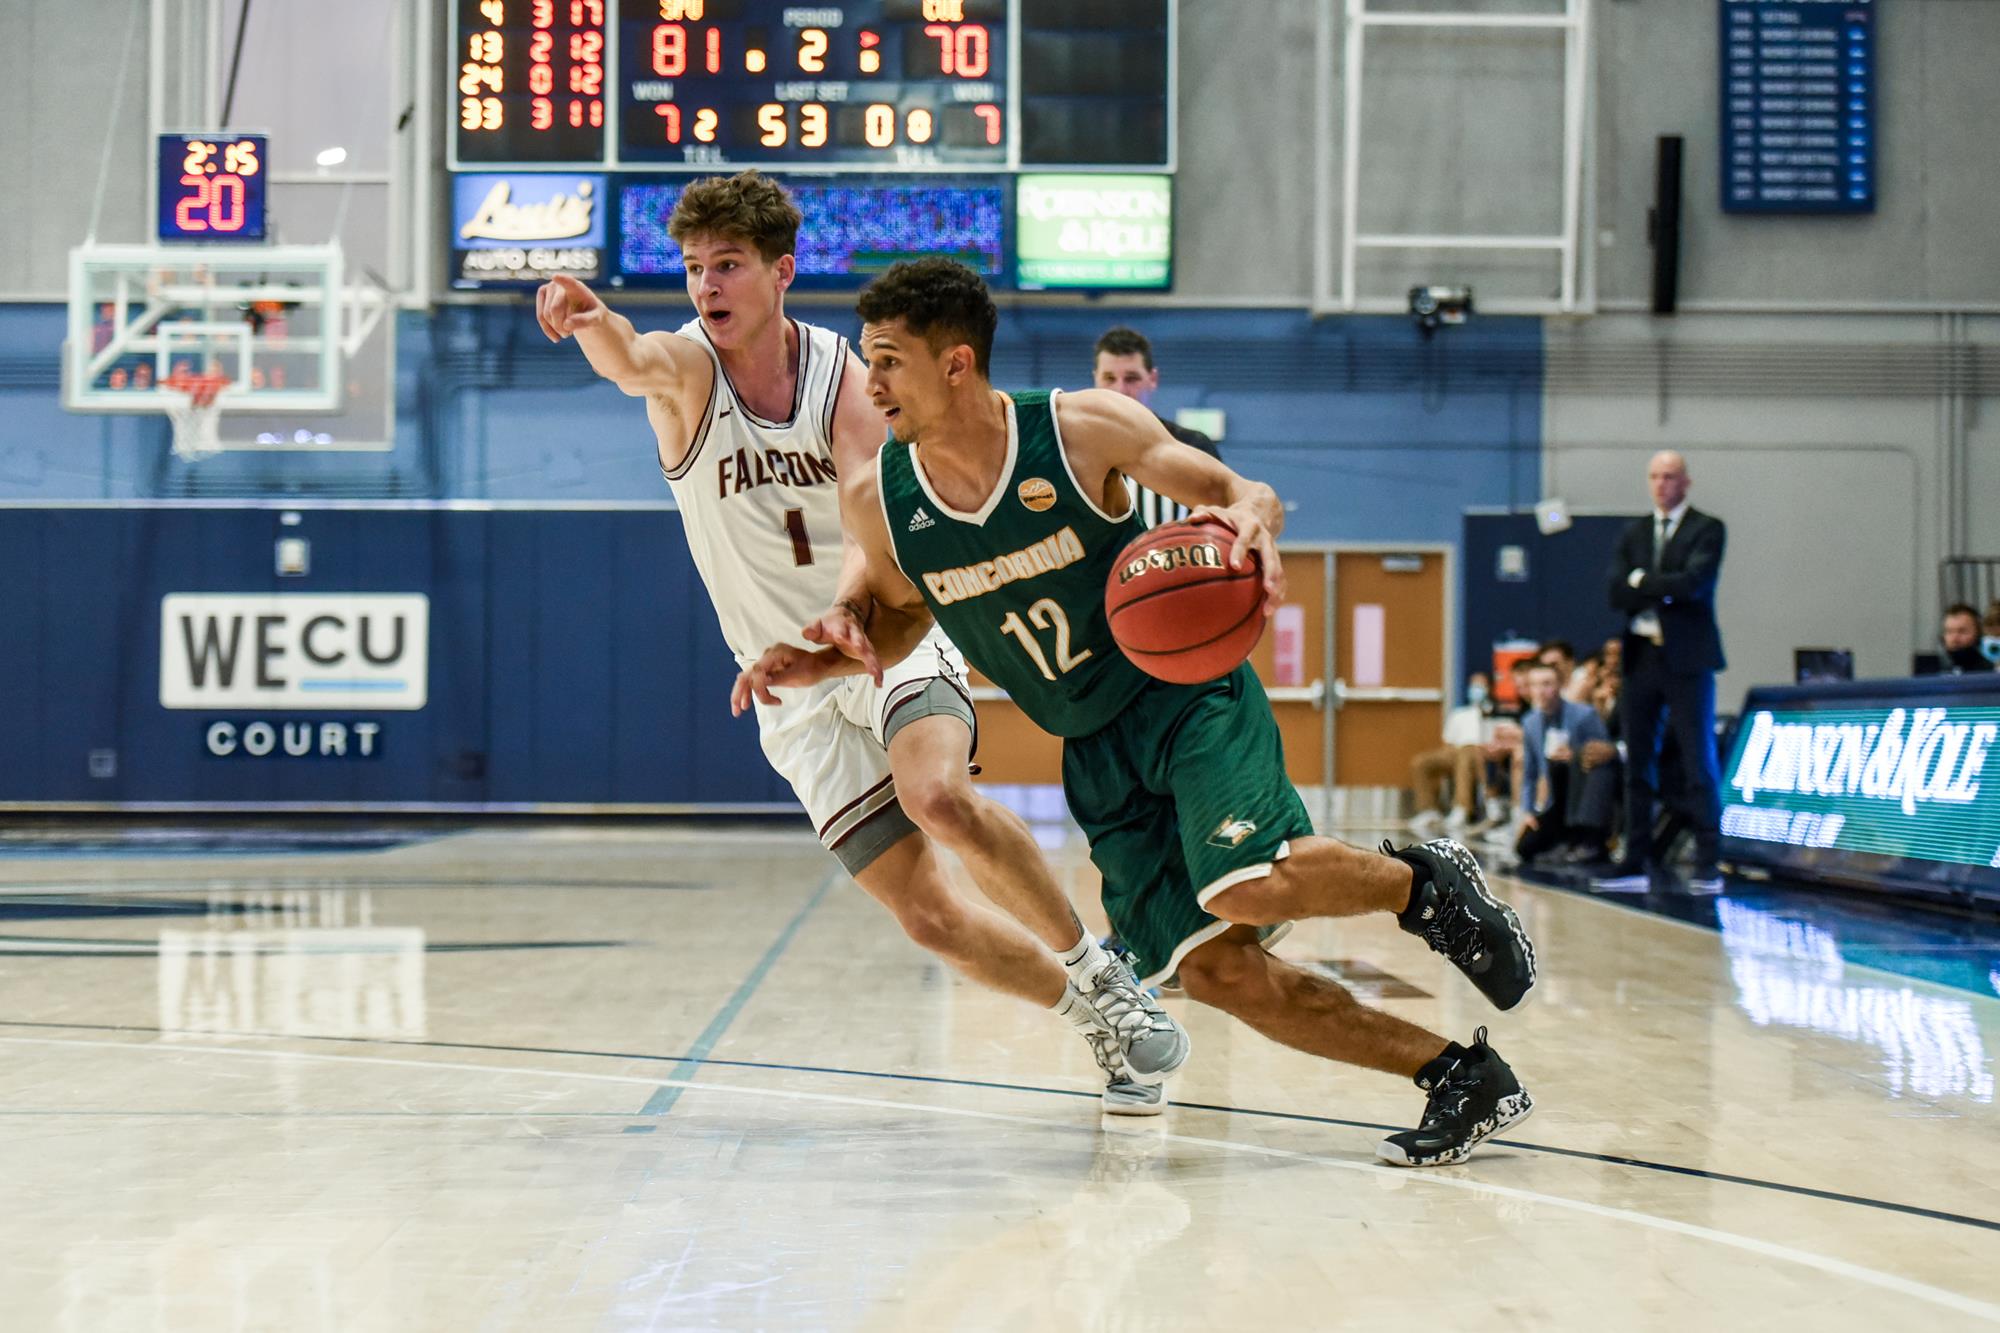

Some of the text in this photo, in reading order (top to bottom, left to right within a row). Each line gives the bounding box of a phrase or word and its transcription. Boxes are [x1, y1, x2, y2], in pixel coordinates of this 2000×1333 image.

[532, 0, 554, 28] 3
[570, 0, 604, 26] 17
[783, 7, 843, 28] PERIOD
[470, 30, 603, 63] 13 2 12
[652, 24, 720, 76] 81
[798, 29, 828, 72] 2
[923, 25, 988, 78] 70
[460, 63, 603, 96] 24 0 12
[632, 81, 674, 101] WON
[775, 82, 848, 101] LAST SET
[952, 83, 995, 102] WON
[461, 97, 603, 130] 33 3 11
[654, 103, 681, 144] 7
[694, 108, 718, 142] 2
[974, 104, 1001, 145] 7
[183, 140, 259, 176] 2:15
[176, 174, 245, 231] 20
[783, 507, 815, 568] 1
[907, 518, 936, 533] adidas
[920, 525, 1087, 607] CONCORDIA
[1119, 543, 1227, 586] Wilson
[179, 614, 405, 689] WECU
[999, 597, 1094, 682] 12
[206, 721, 381, 757] COURT
